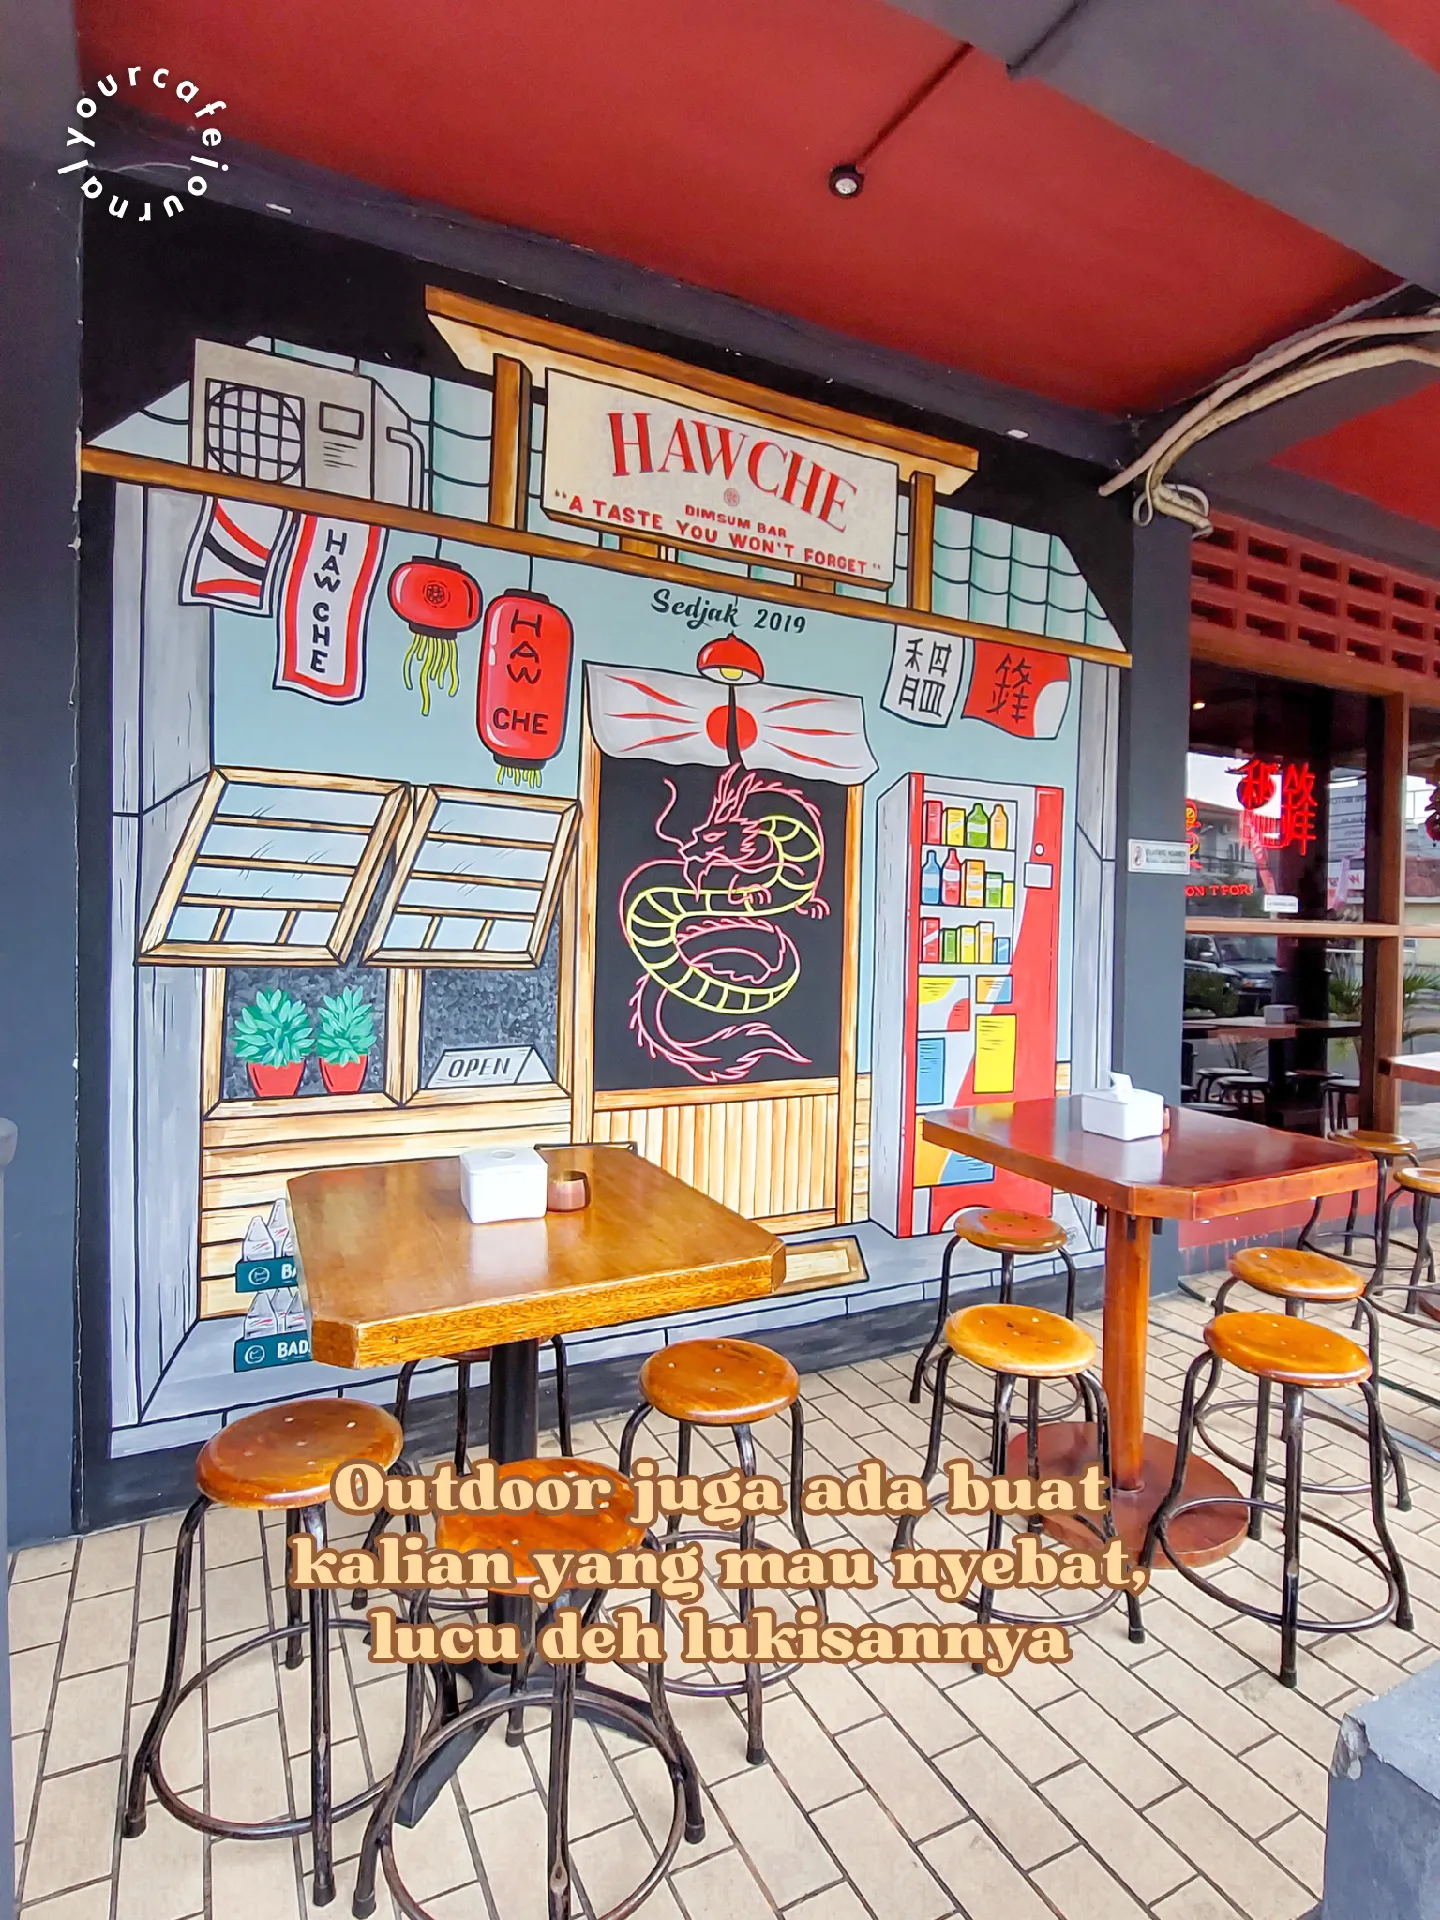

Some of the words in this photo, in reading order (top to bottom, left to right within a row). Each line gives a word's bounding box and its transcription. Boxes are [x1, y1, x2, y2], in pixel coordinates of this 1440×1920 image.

[607, 412, 858, 533] HAWCHE
[592, 499, 664, 531] TASTE
[675, 519, 719, 544] YOU
[728, 532, 796, 558] WON'T
[684, 504, 751, 529] DIMSUM
[756, 521, 788, 539] BAR
[651, 588, 743, 629] Sedjak
[753, 608, 807, 635] 2019
[506, 608, 543, 685] HAW
[492, 707, 549, 735] CHE
[447, 1057, 511, 1079] OPEN
[277, 1339, 311, 1359] BAD
